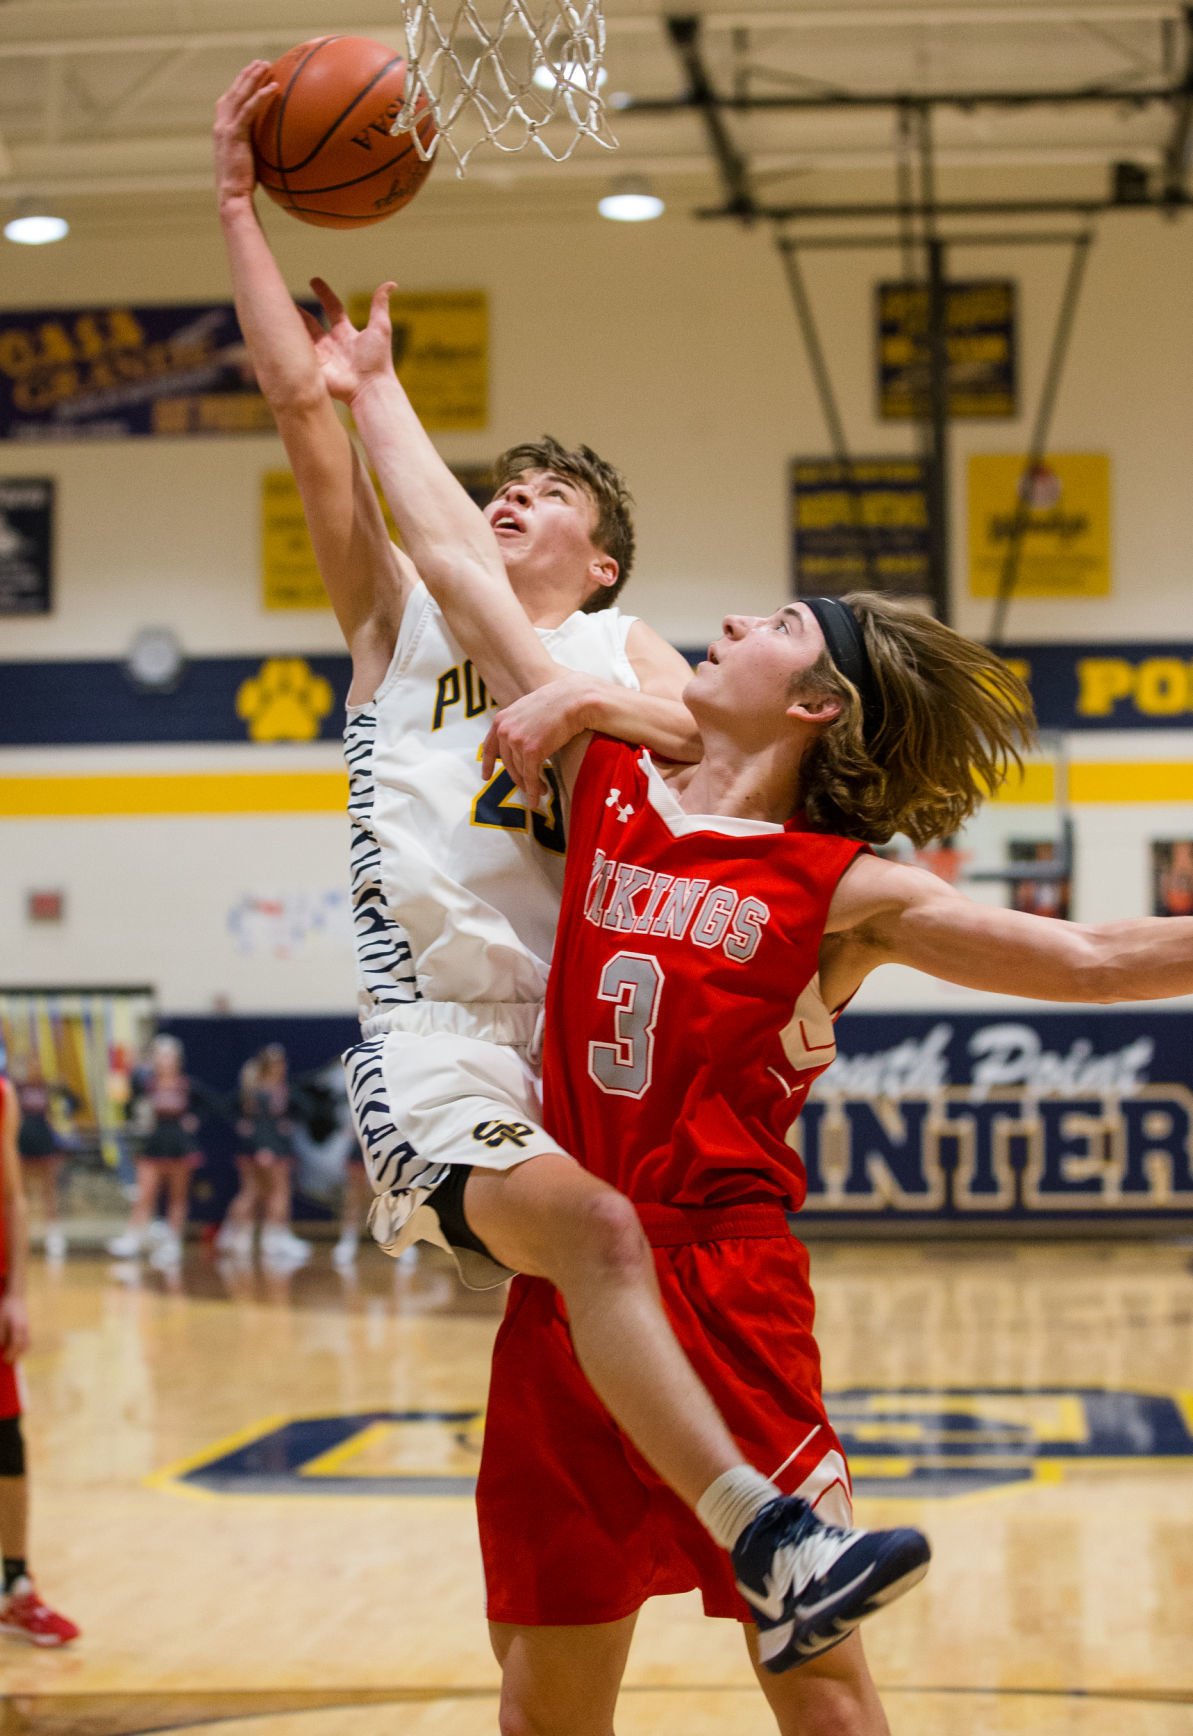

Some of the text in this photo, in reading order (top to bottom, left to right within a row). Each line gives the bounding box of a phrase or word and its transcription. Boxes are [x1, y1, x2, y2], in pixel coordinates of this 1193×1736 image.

[431, 658, 499, 732] PO
[1076, 656, 1193, 717] PO
[588, 951, 665, 1100] 3
[967, 1022, 1155, 1104] Point
[790, 1084, 1193, 1211] INTER
